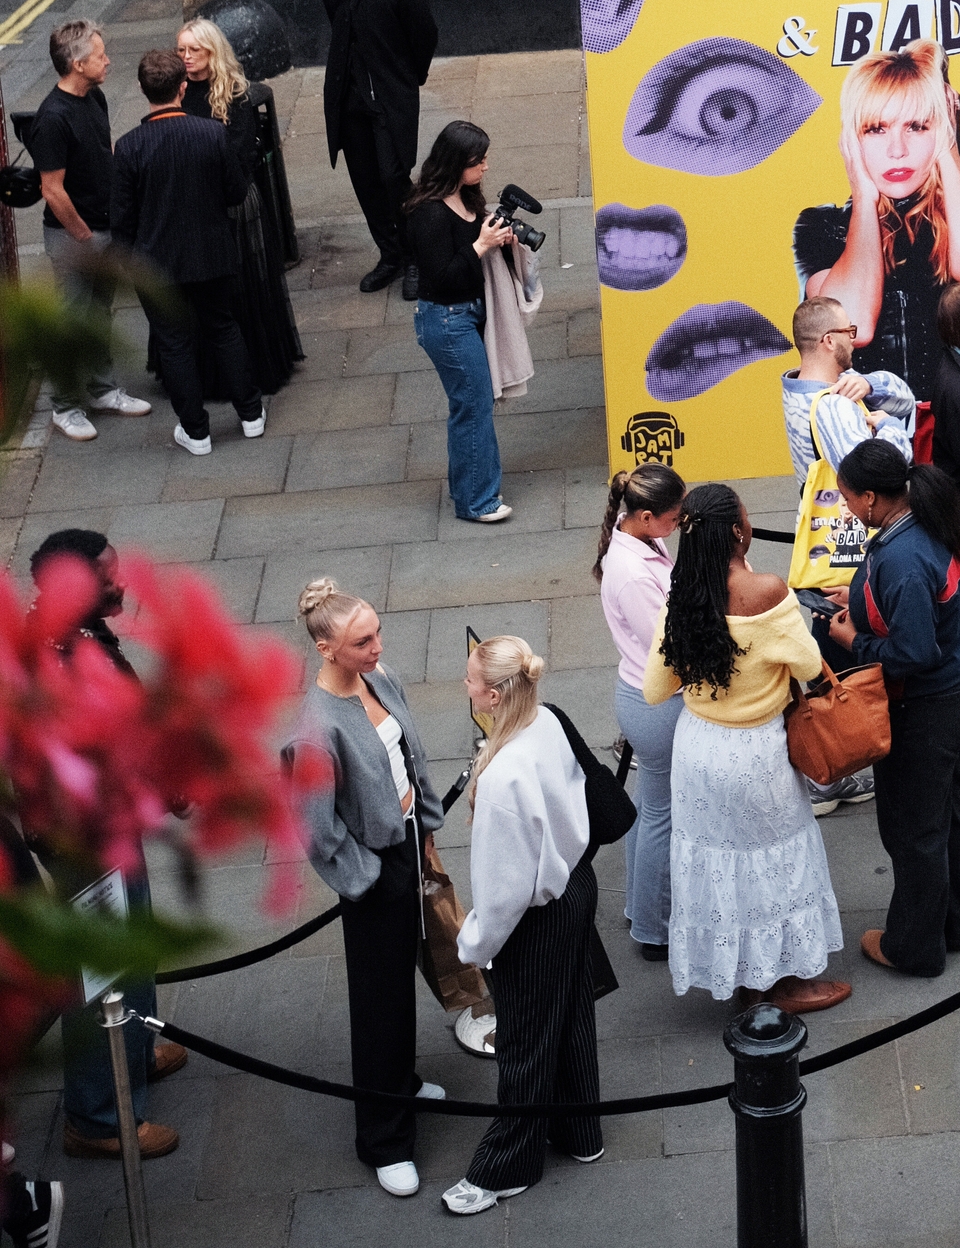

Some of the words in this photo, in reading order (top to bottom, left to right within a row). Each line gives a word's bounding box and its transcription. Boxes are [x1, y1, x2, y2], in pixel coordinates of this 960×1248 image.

[776, 15, 820, 59] &
[635, 432, 671, 454] JAM
[836, 528, 867, 546] BAD
[830, 554, 852, 563] PALOMA
[853, 554, 866, 563] FAIT
